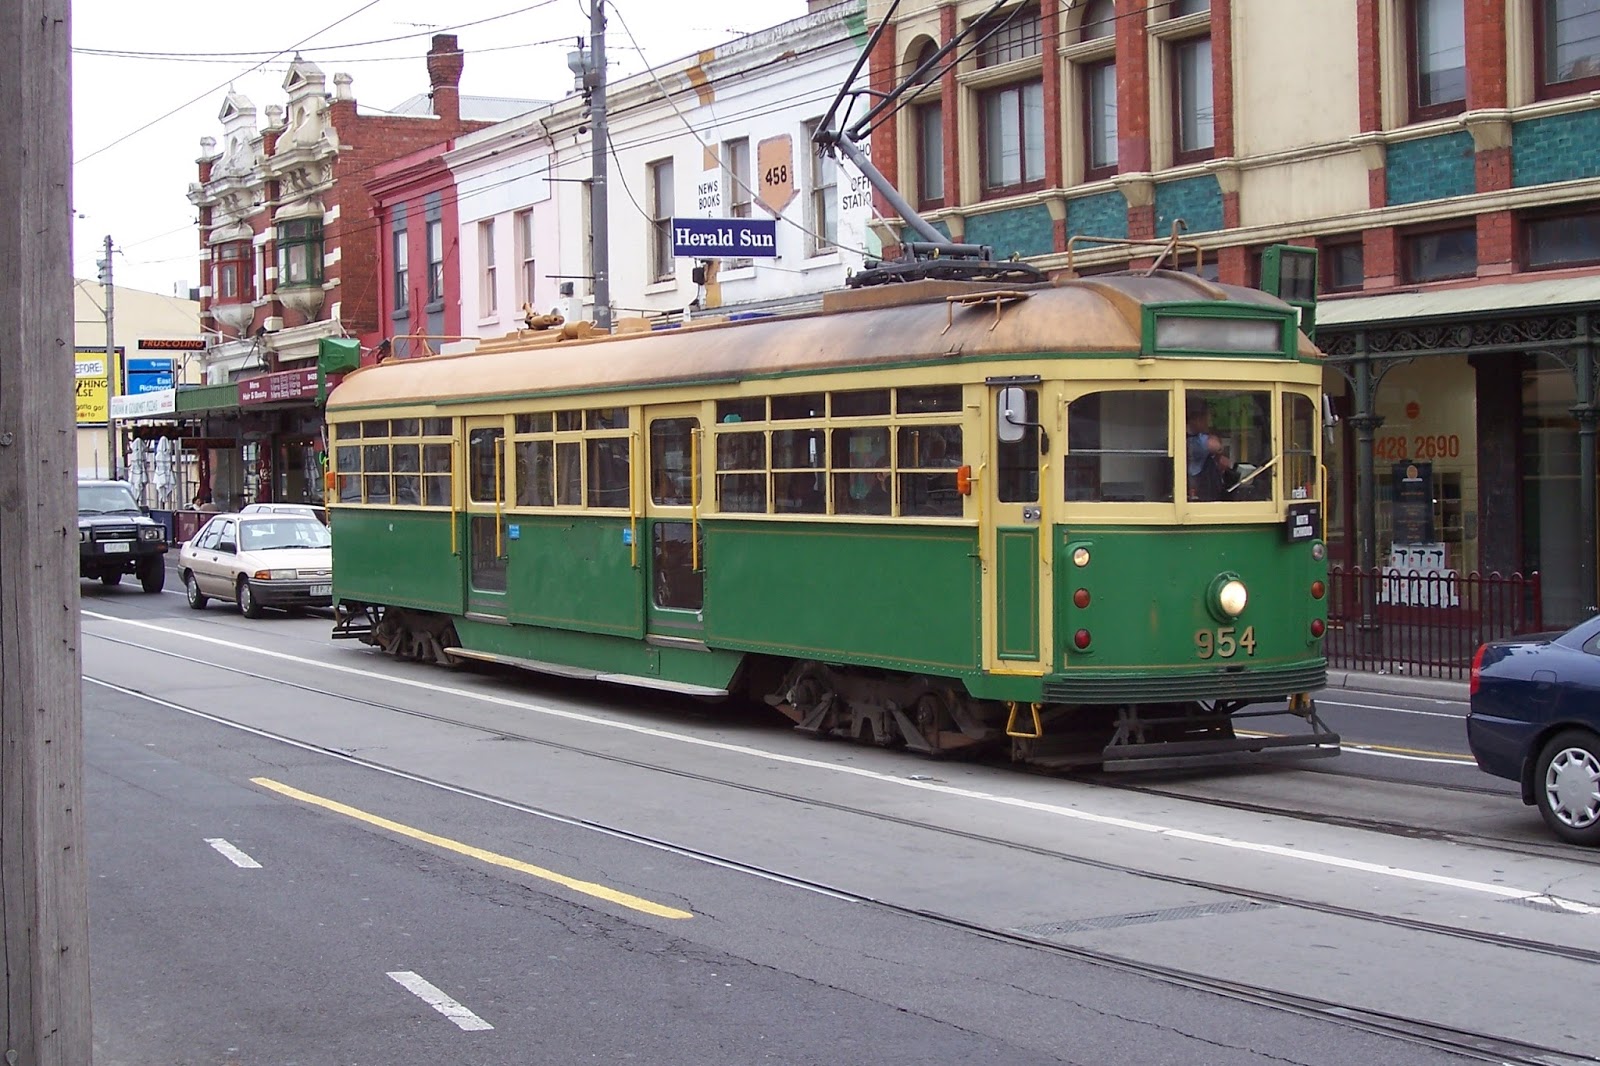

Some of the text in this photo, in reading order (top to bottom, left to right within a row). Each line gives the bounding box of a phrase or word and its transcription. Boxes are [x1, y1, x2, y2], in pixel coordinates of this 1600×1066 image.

[765, 164, 787, 186] 458
[851, 175, 870, 192] OFFI
[698, 180, 719, 196] NEWS
[698, 193, 720, 210] BOOKS
[842, 192, 872, 210] STATIO
[675, 228, 774, 247] Herald Sun
[139, 384, 172, 392] Richmond
[157, 377, 172, 385] East
[1414, 434, 1460, 459] 2690
[1195, 626, 1256, 660] 954
